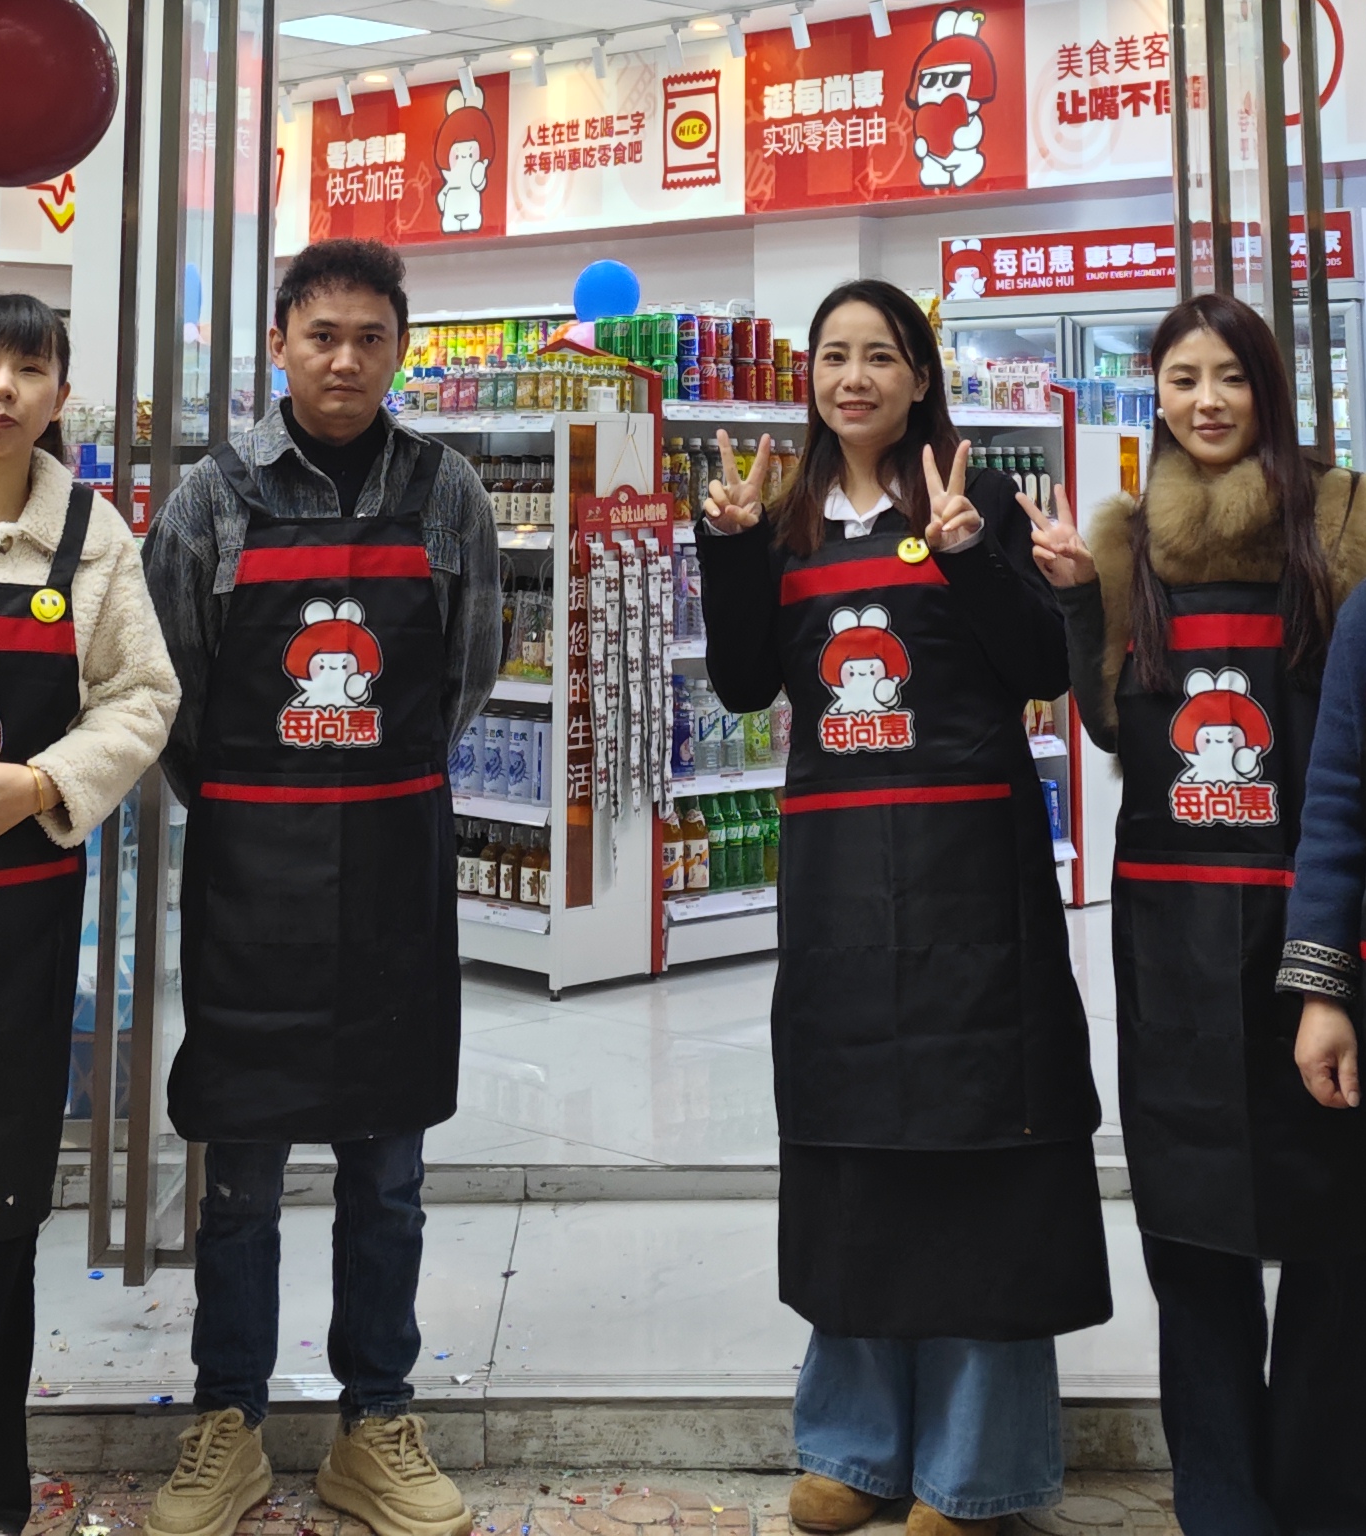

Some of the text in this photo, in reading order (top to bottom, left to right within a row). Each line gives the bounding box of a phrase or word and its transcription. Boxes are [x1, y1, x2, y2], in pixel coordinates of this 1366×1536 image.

[1057, 32, 1170, 81] 美食美客
[762, 70, 885, 121] 逛每尚惠
[522, 111, 646, 148] 人生在世 吃喝二字
[762, 115, 887, 158] 实现零食自由
[524, 141, 643, 176] 来每尚惠吃零食吧
[326, 165, 405, 207] 快乐加倍
[994, 246, 1074, 276] 每尚惠
[995, 275, 1075, 290] MEI SHANG HUI
[282, 709, 378, 743] 每尚惠
[822, 713, 909, 748] 每尚惠
[1174, 785, 1273, 822] 每尚惠
